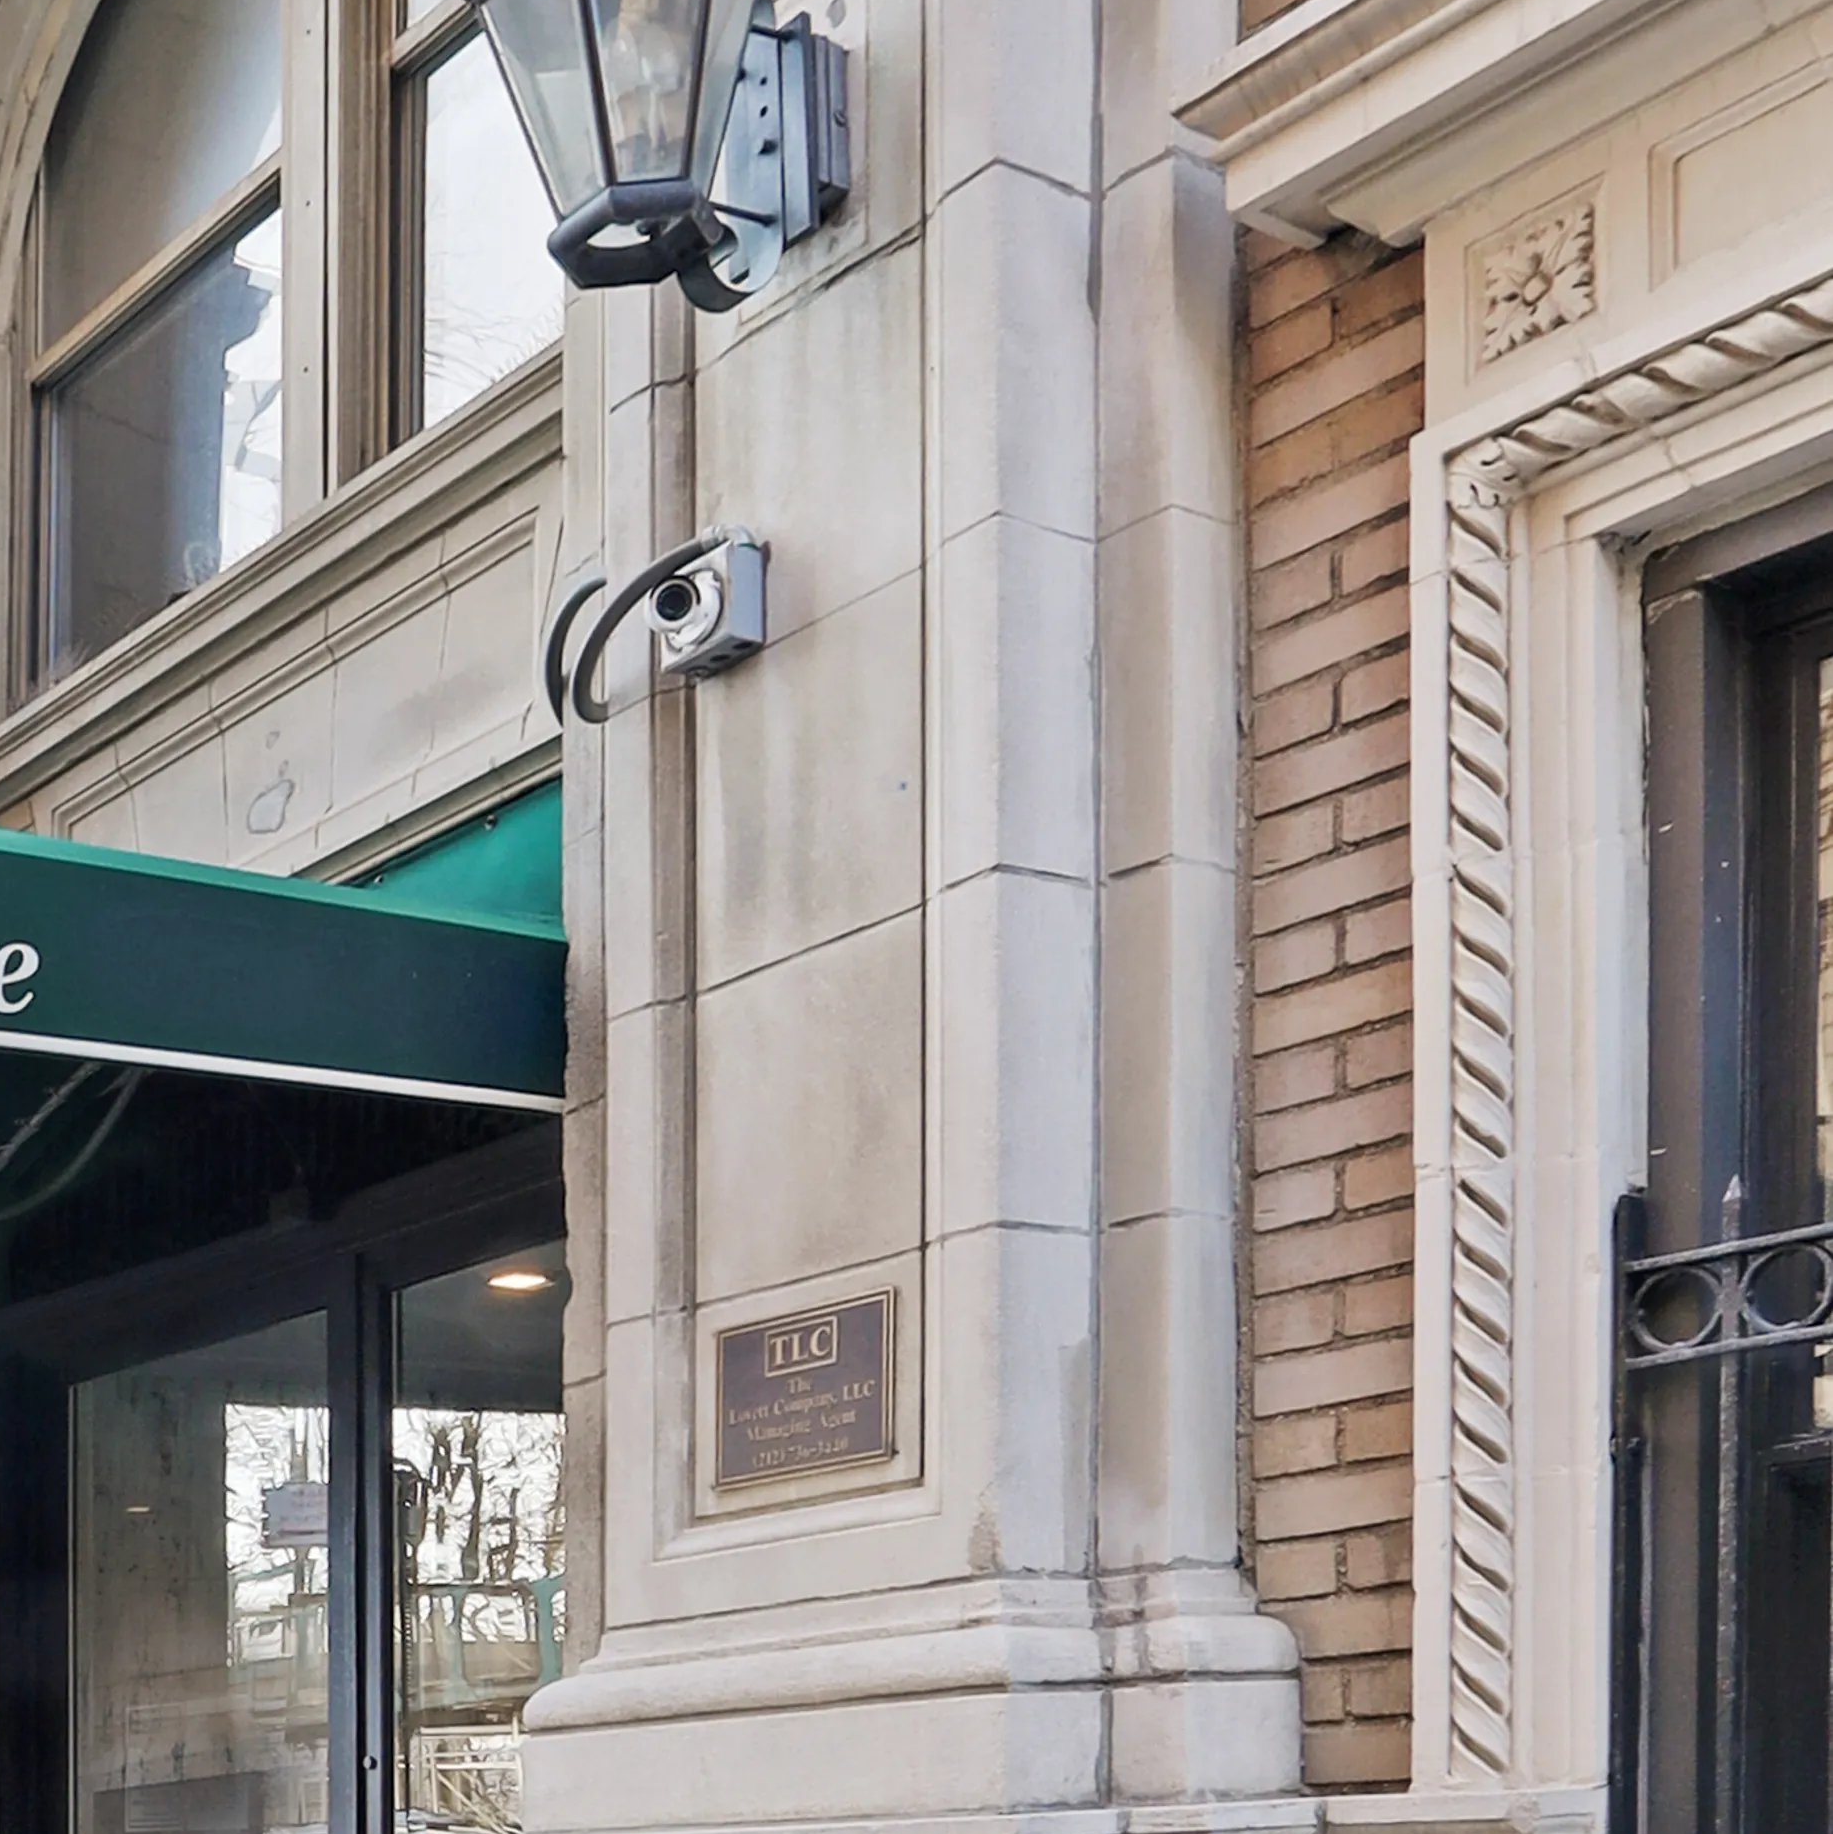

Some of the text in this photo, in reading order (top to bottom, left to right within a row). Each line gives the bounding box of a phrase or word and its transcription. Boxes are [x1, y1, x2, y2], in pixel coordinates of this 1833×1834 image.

[770, 1325, 831, 1367] TLC
[787, 1378, 811, 1394] The
[842, 1379, 876, 1401] LLC
